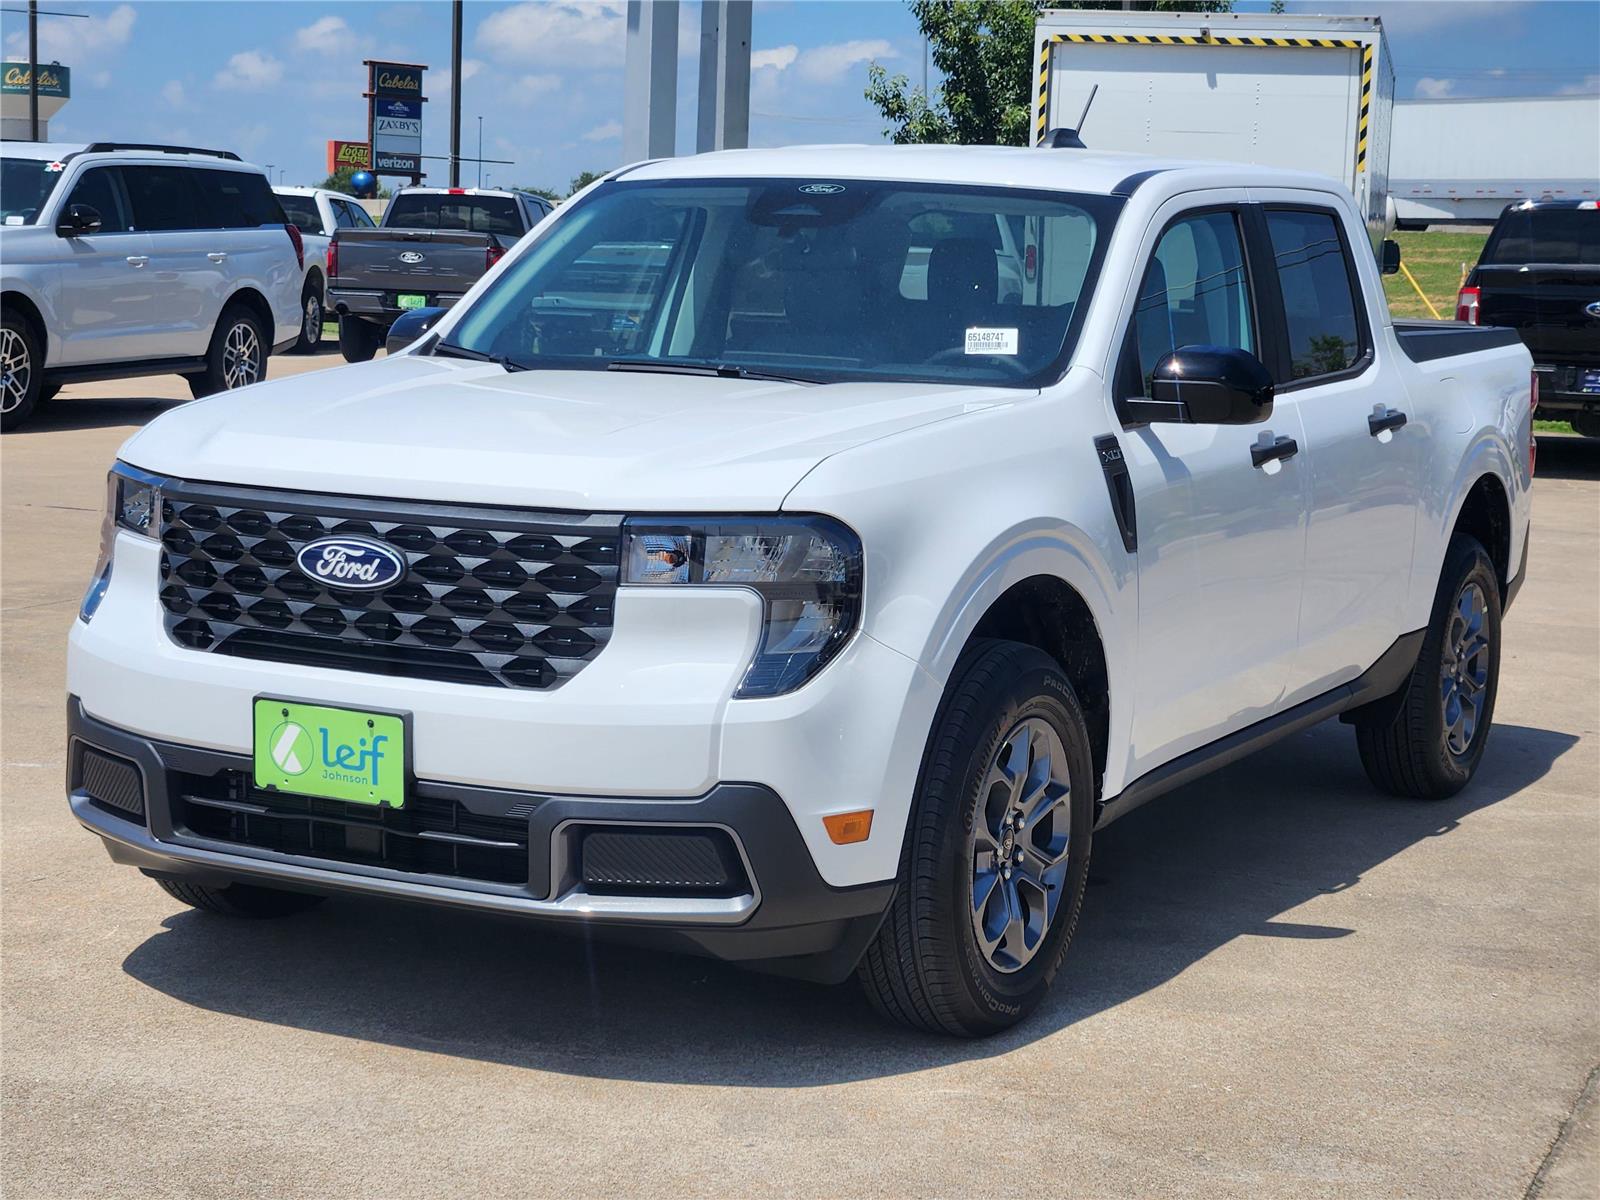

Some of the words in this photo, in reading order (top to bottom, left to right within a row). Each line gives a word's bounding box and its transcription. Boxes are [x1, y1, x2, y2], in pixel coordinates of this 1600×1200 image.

[5, 67, 58, 86] Cabla's
[379, 72, 418, 90] Cabela's
[378, 119, 419, 133] ZAXBY'S
[377, 156, 414, 169] verizon
[967, 332, 1005, 342] 6514874T
[316, 545, 381, 581] Ford
[322, 769, 368, 785] Johnson
